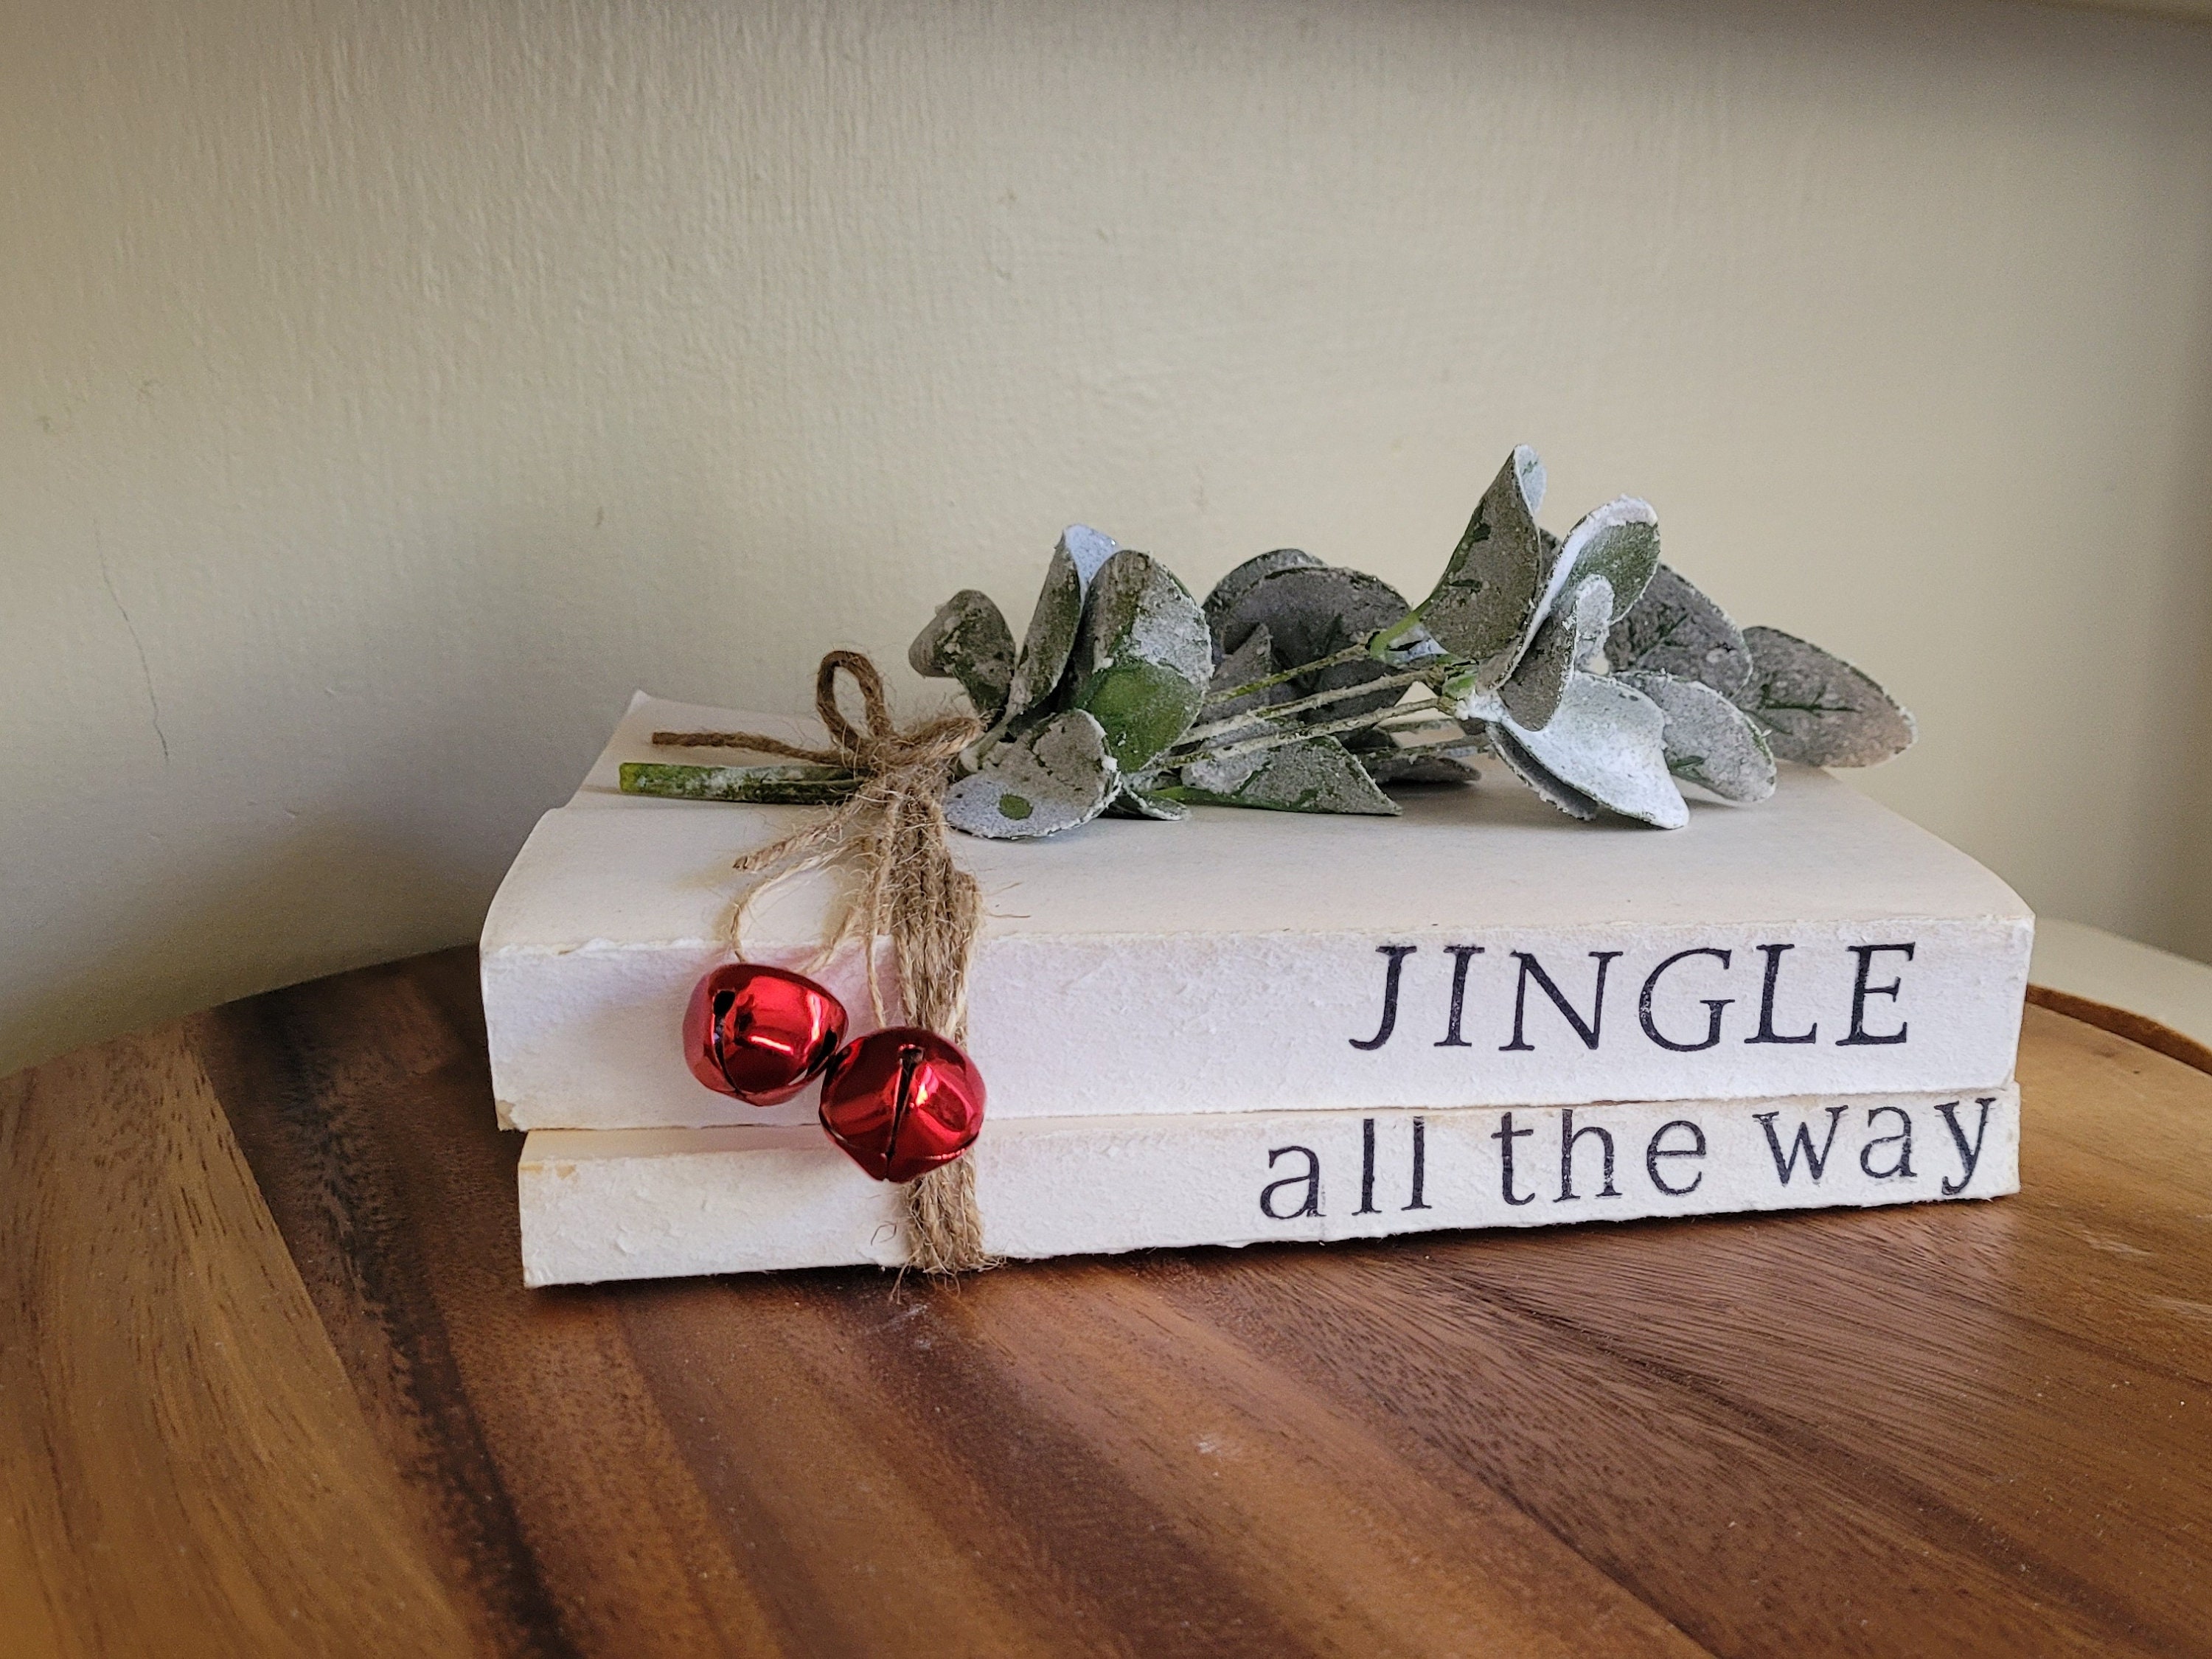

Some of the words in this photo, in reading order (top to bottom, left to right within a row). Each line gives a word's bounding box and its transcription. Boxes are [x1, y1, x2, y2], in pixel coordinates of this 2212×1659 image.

[1348, 942, 1916, 1053] JINGLE
[1259, 1116, 1433, 1220] all
[1490, 1107, 1707, 1206] the
[1751, 1097, 1997, 1196] way
